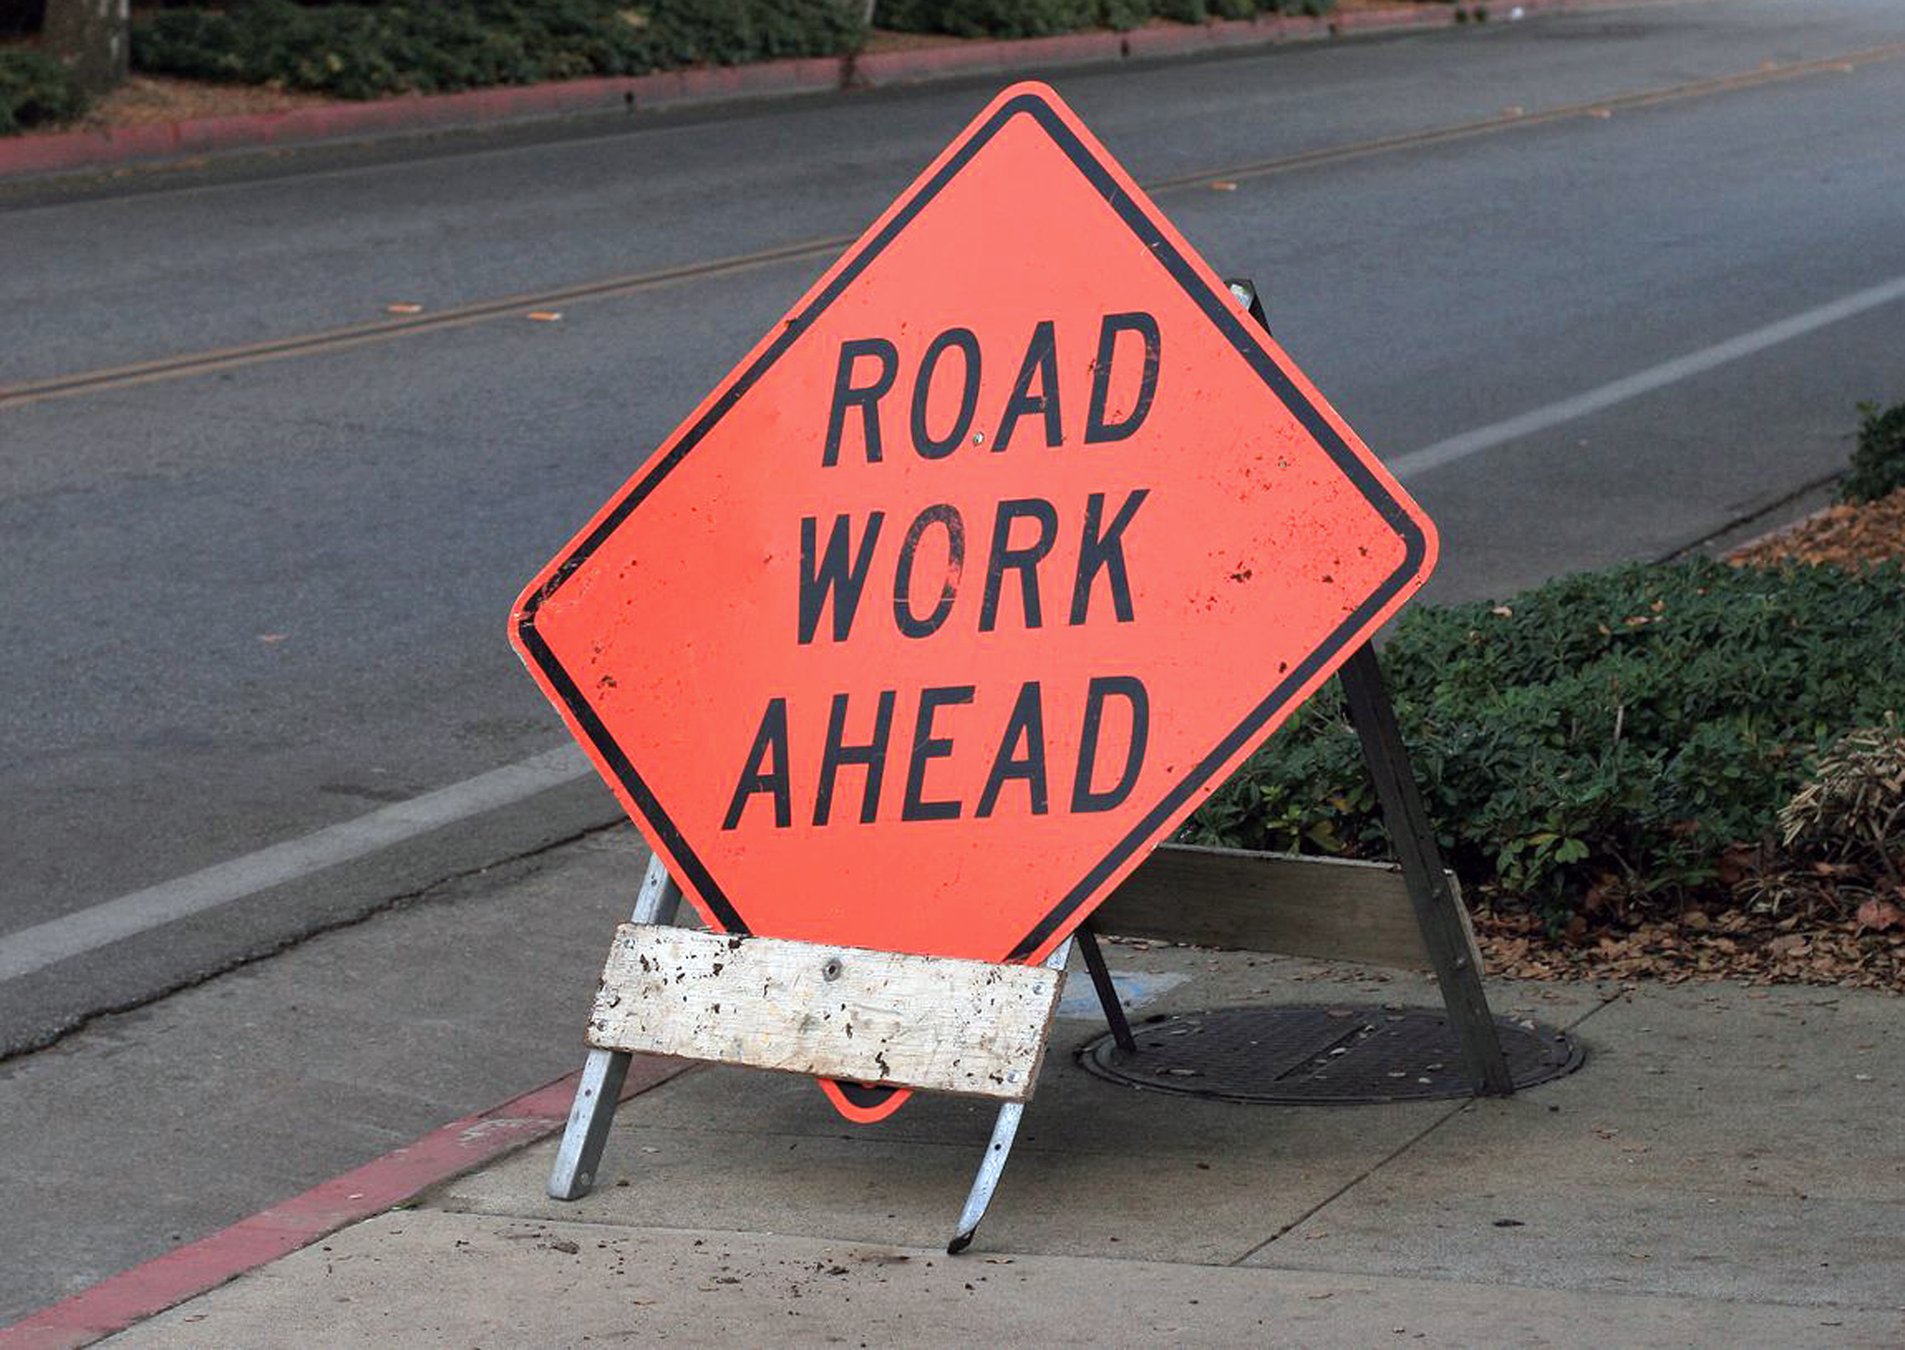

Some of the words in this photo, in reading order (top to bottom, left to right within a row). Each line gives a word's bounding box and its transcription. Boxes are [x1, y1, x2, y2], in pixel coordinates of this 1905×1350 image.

[823, 312, 1161, 467] ROAD
[799, 490, 1150, 644] WORK
[722, 676, 1149, 830] AHEAD
